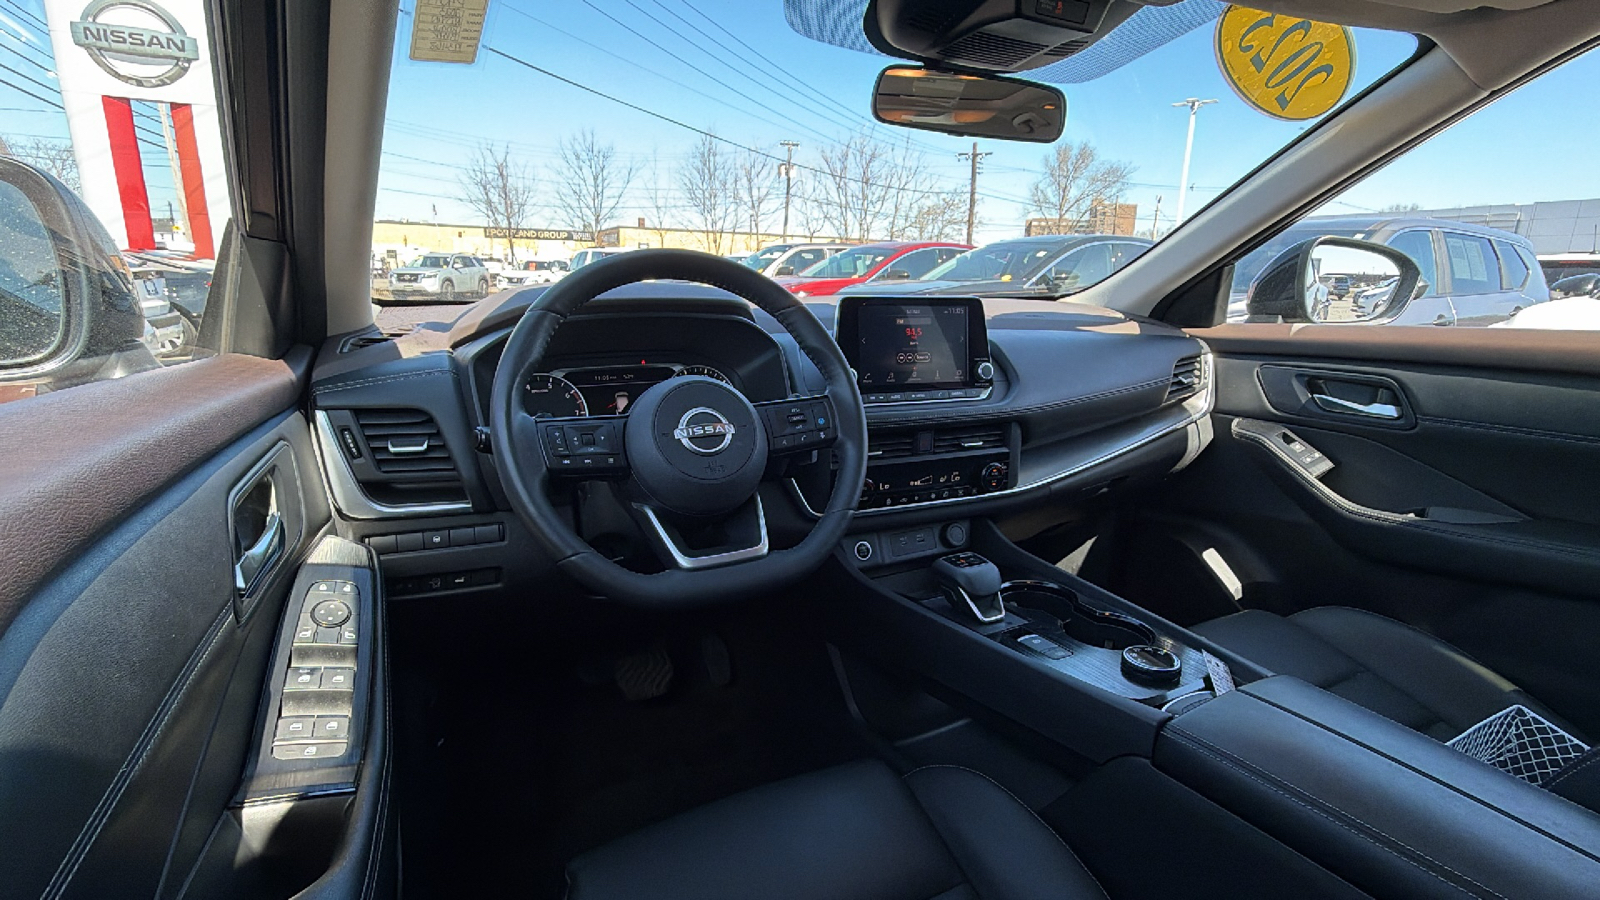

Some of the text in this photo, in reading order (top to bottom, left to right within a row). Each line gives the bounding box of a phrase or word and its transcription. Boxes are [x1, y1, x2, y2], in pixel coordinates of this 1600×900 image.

[83, 26, 186, 53] NISSAN
[537, 230, 568, 240] GROUP
[905, 327, 923, 336] 94.5
[676, 423, 736, 438] NISSAN
